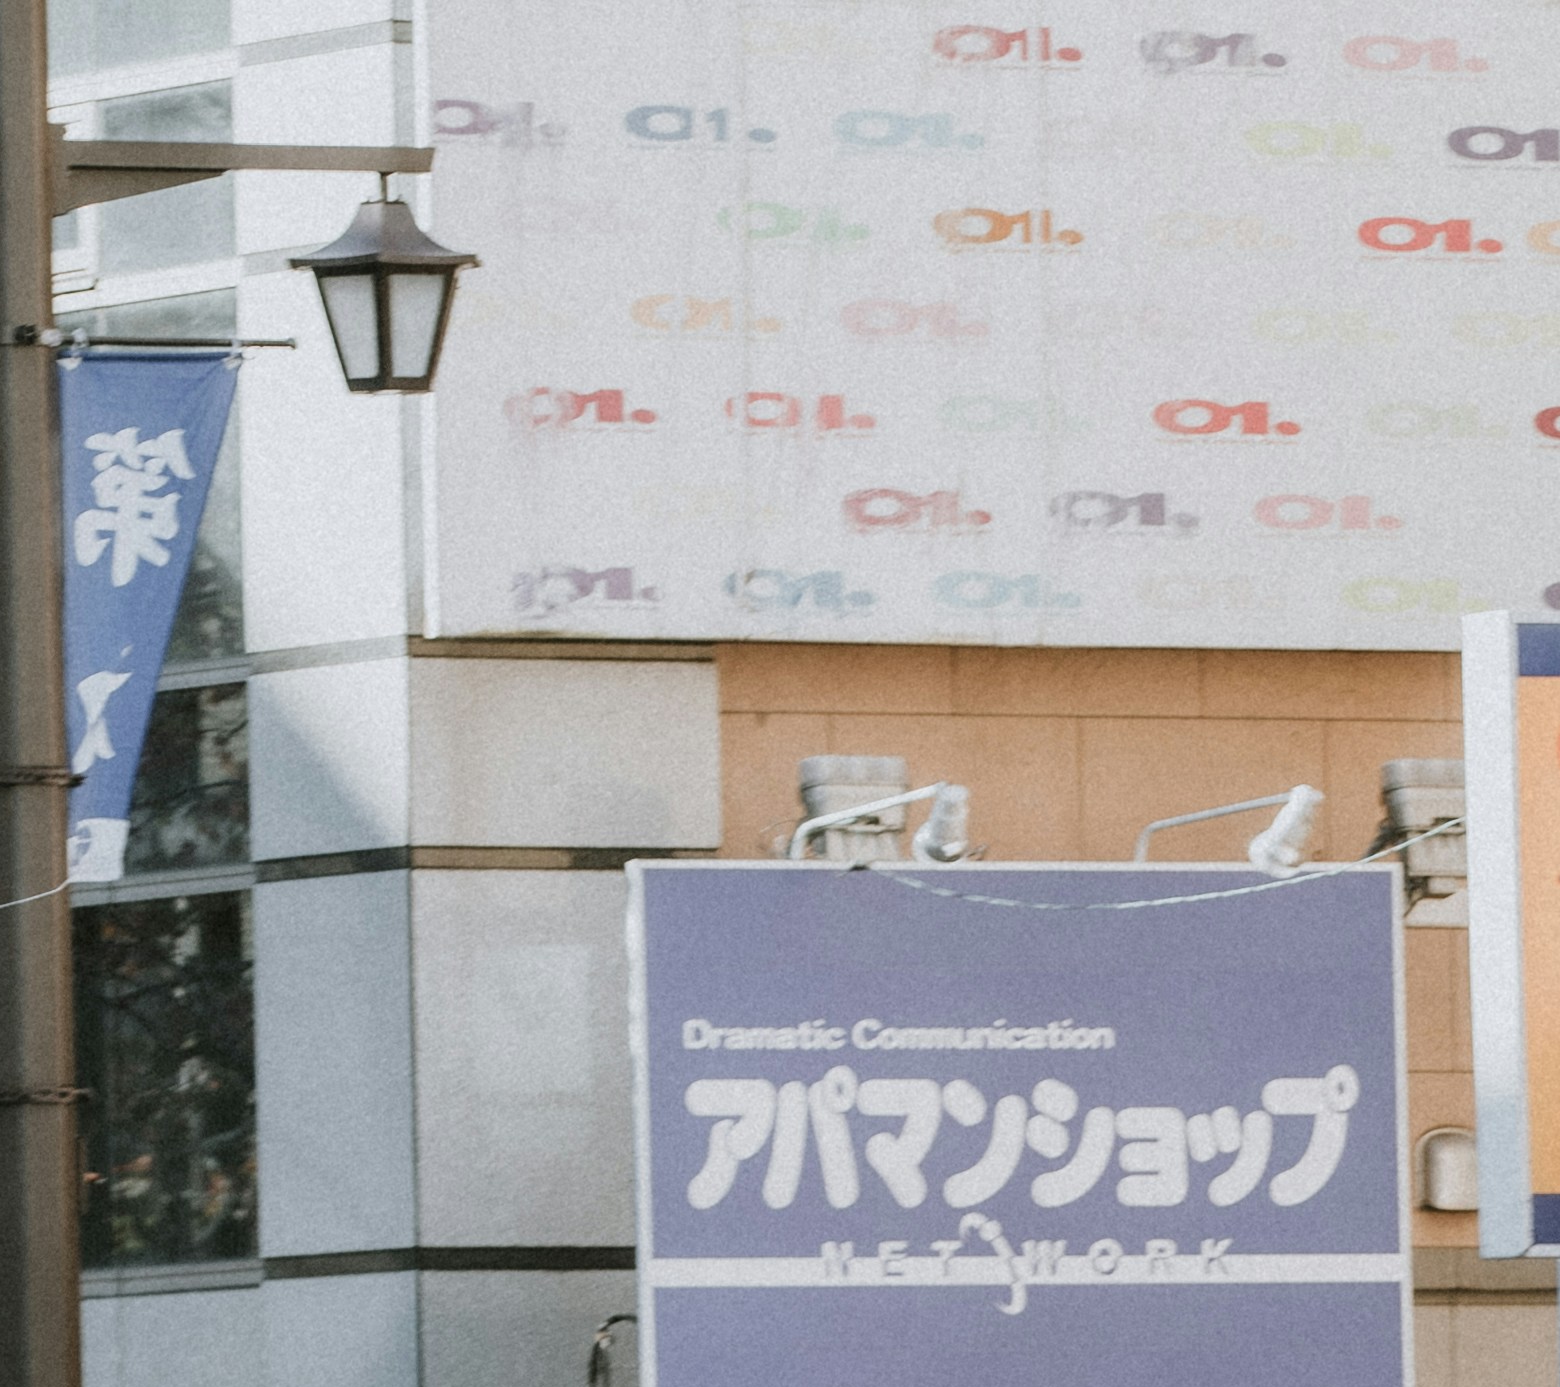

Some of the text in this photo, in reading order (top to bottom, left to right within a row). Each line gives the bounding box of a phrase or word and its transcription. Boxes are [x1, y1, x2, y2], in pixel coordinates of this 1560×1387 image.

[682, 1018, 1117, 1051] Dramatic Communication
[684, 1064, 1361, 1210] アパマンショップ
